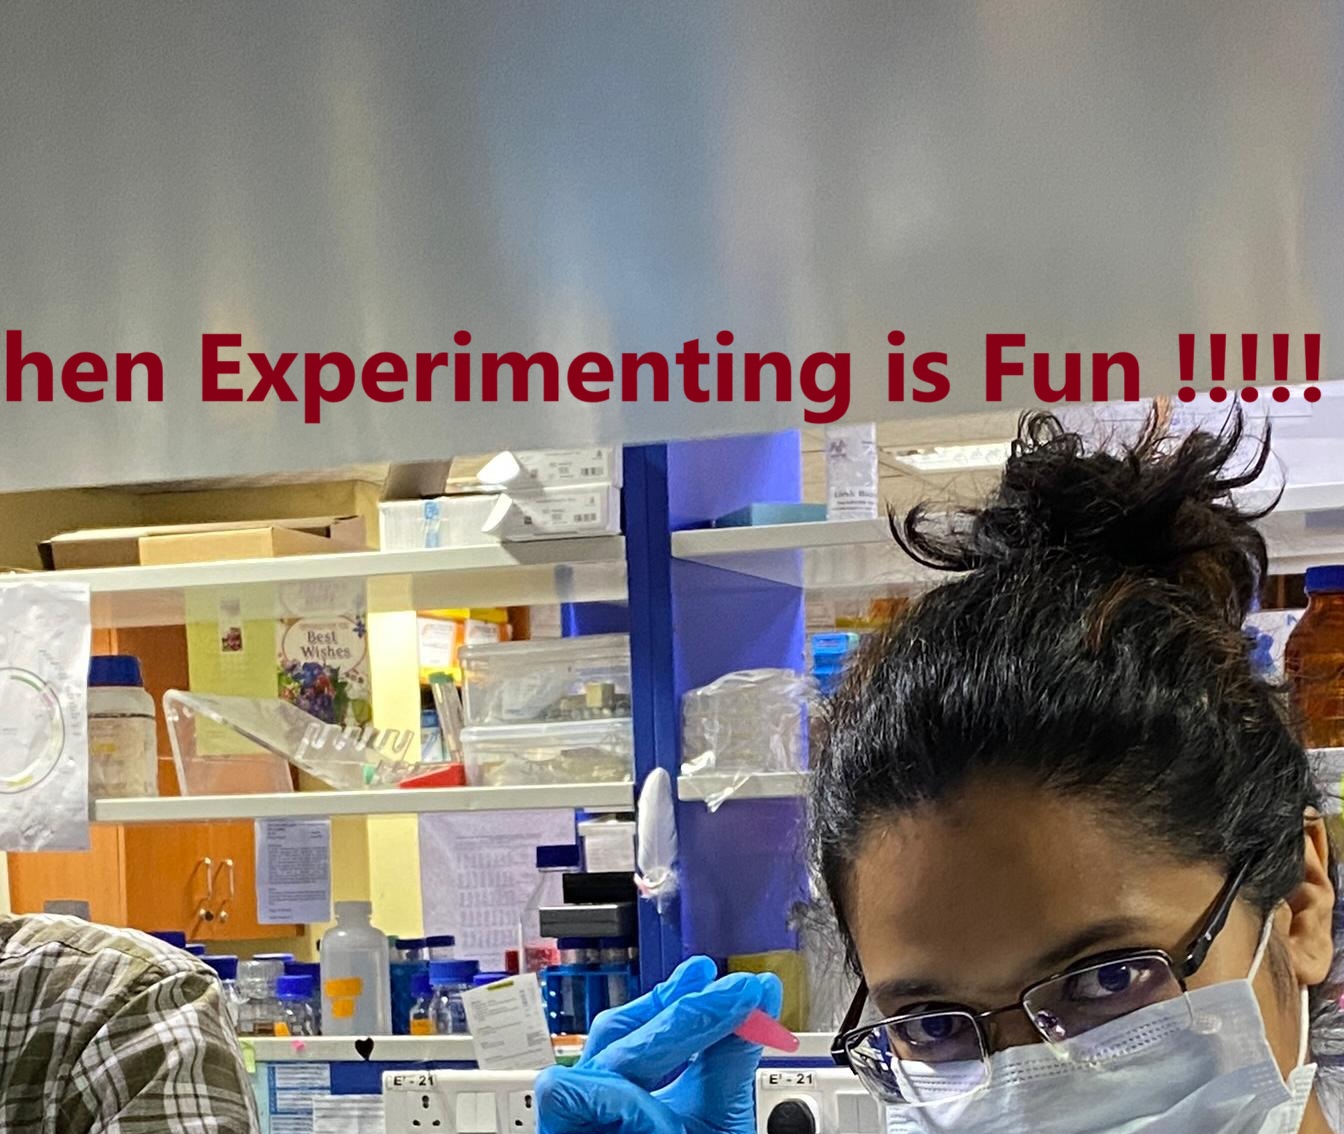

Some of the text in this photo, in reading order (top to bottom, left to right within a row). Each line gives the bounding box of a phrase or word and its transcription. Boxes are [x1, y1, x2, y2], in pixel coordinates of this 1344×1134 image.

[307, 631, 338, 645] Best
[300, 645, 352, 658] Wishes
[418, 1075, 434, 1086] 21
[796, 1073, 813, 1084] 21
